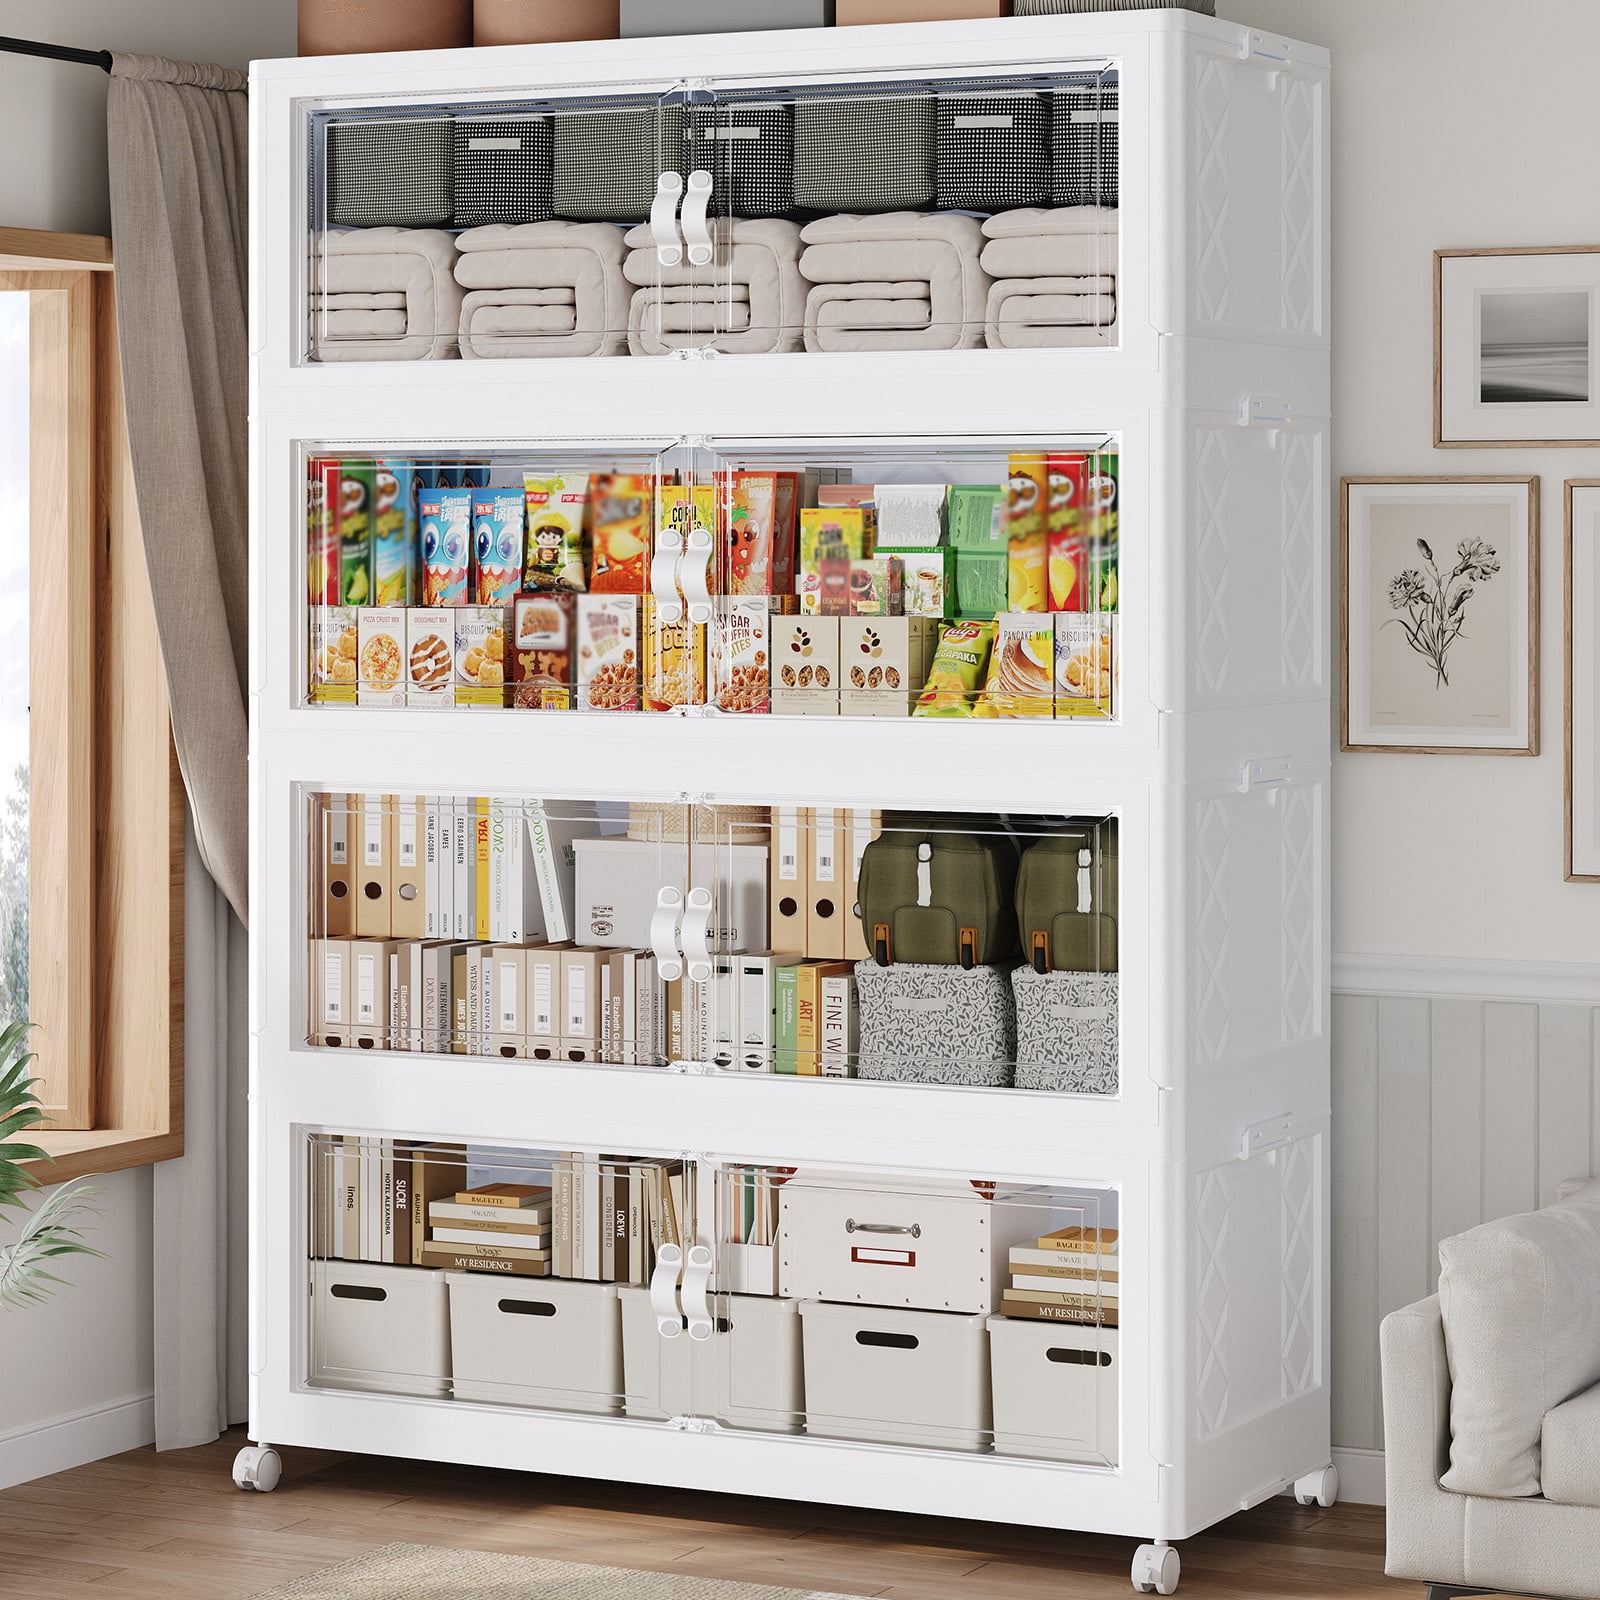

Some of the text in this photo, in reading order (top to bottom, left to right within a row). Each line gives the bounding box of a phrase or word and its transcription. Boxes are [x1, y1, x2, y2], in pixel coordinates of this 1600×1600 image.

[460, 624, 484, 635] BISCUIT
[1003, 630, 1048, 641] PANCAKE MIX
[427, 832, 435, 863] JACOBSEN
[457, 834, 465, 865] SAARINEN
[470, 965, 478, 991] WIVES
[457, 998, 465, 1020] JAMES
[470, 992, 478, 1010] AND
[613, 996, 621, 1031] Elizabeth
[799, 999, 813, 1022] ART
[826, 995, 842, 1031] FINE
[672, 1010, 681, 1055] JAMES JOYCE
[347, 1186, 356, 1212] lines.
[396, 1179, 407, 1210] SUCRE
[471, 1196, 505, 1205] BAGUETTE
[605, 1196, 613, 1248] CONSIDERED
[616, 1210, 625, 1238] LOEWE
[454, 1257, 513, 1271] MY RESIDENCE
[475, 1245, 501, 1257] Voyage
[1039, 1307, 1054, 1316] MY
